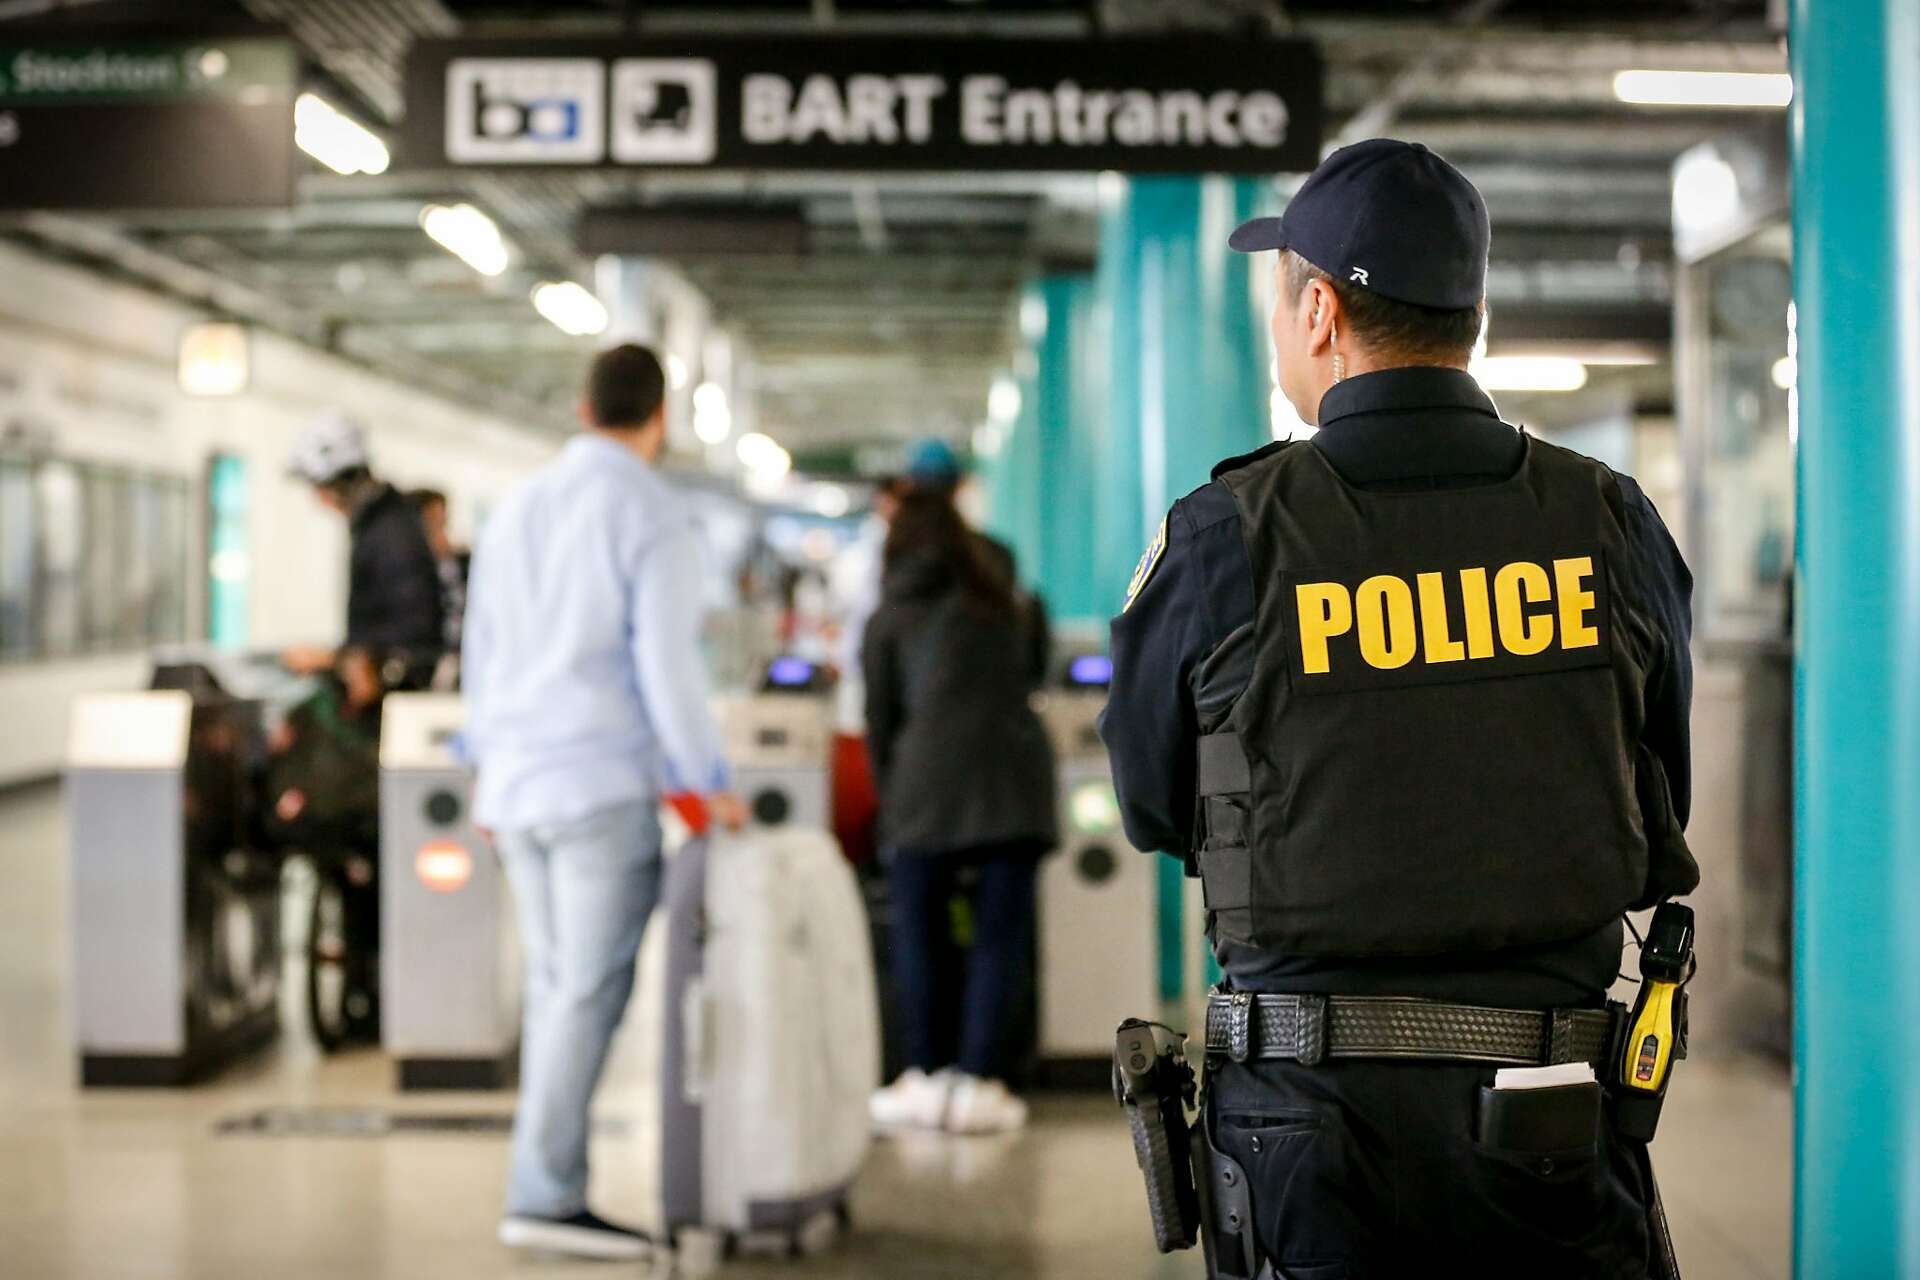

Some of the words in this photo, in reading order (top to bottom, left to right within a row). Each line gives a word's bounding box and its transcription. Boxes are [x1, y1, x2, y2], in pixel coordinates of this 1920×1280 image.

[740, 73, 944, 145] BART
[961, 74, 1289, 147] Entrance
[1295, 556, 1599, 674] POLICE
